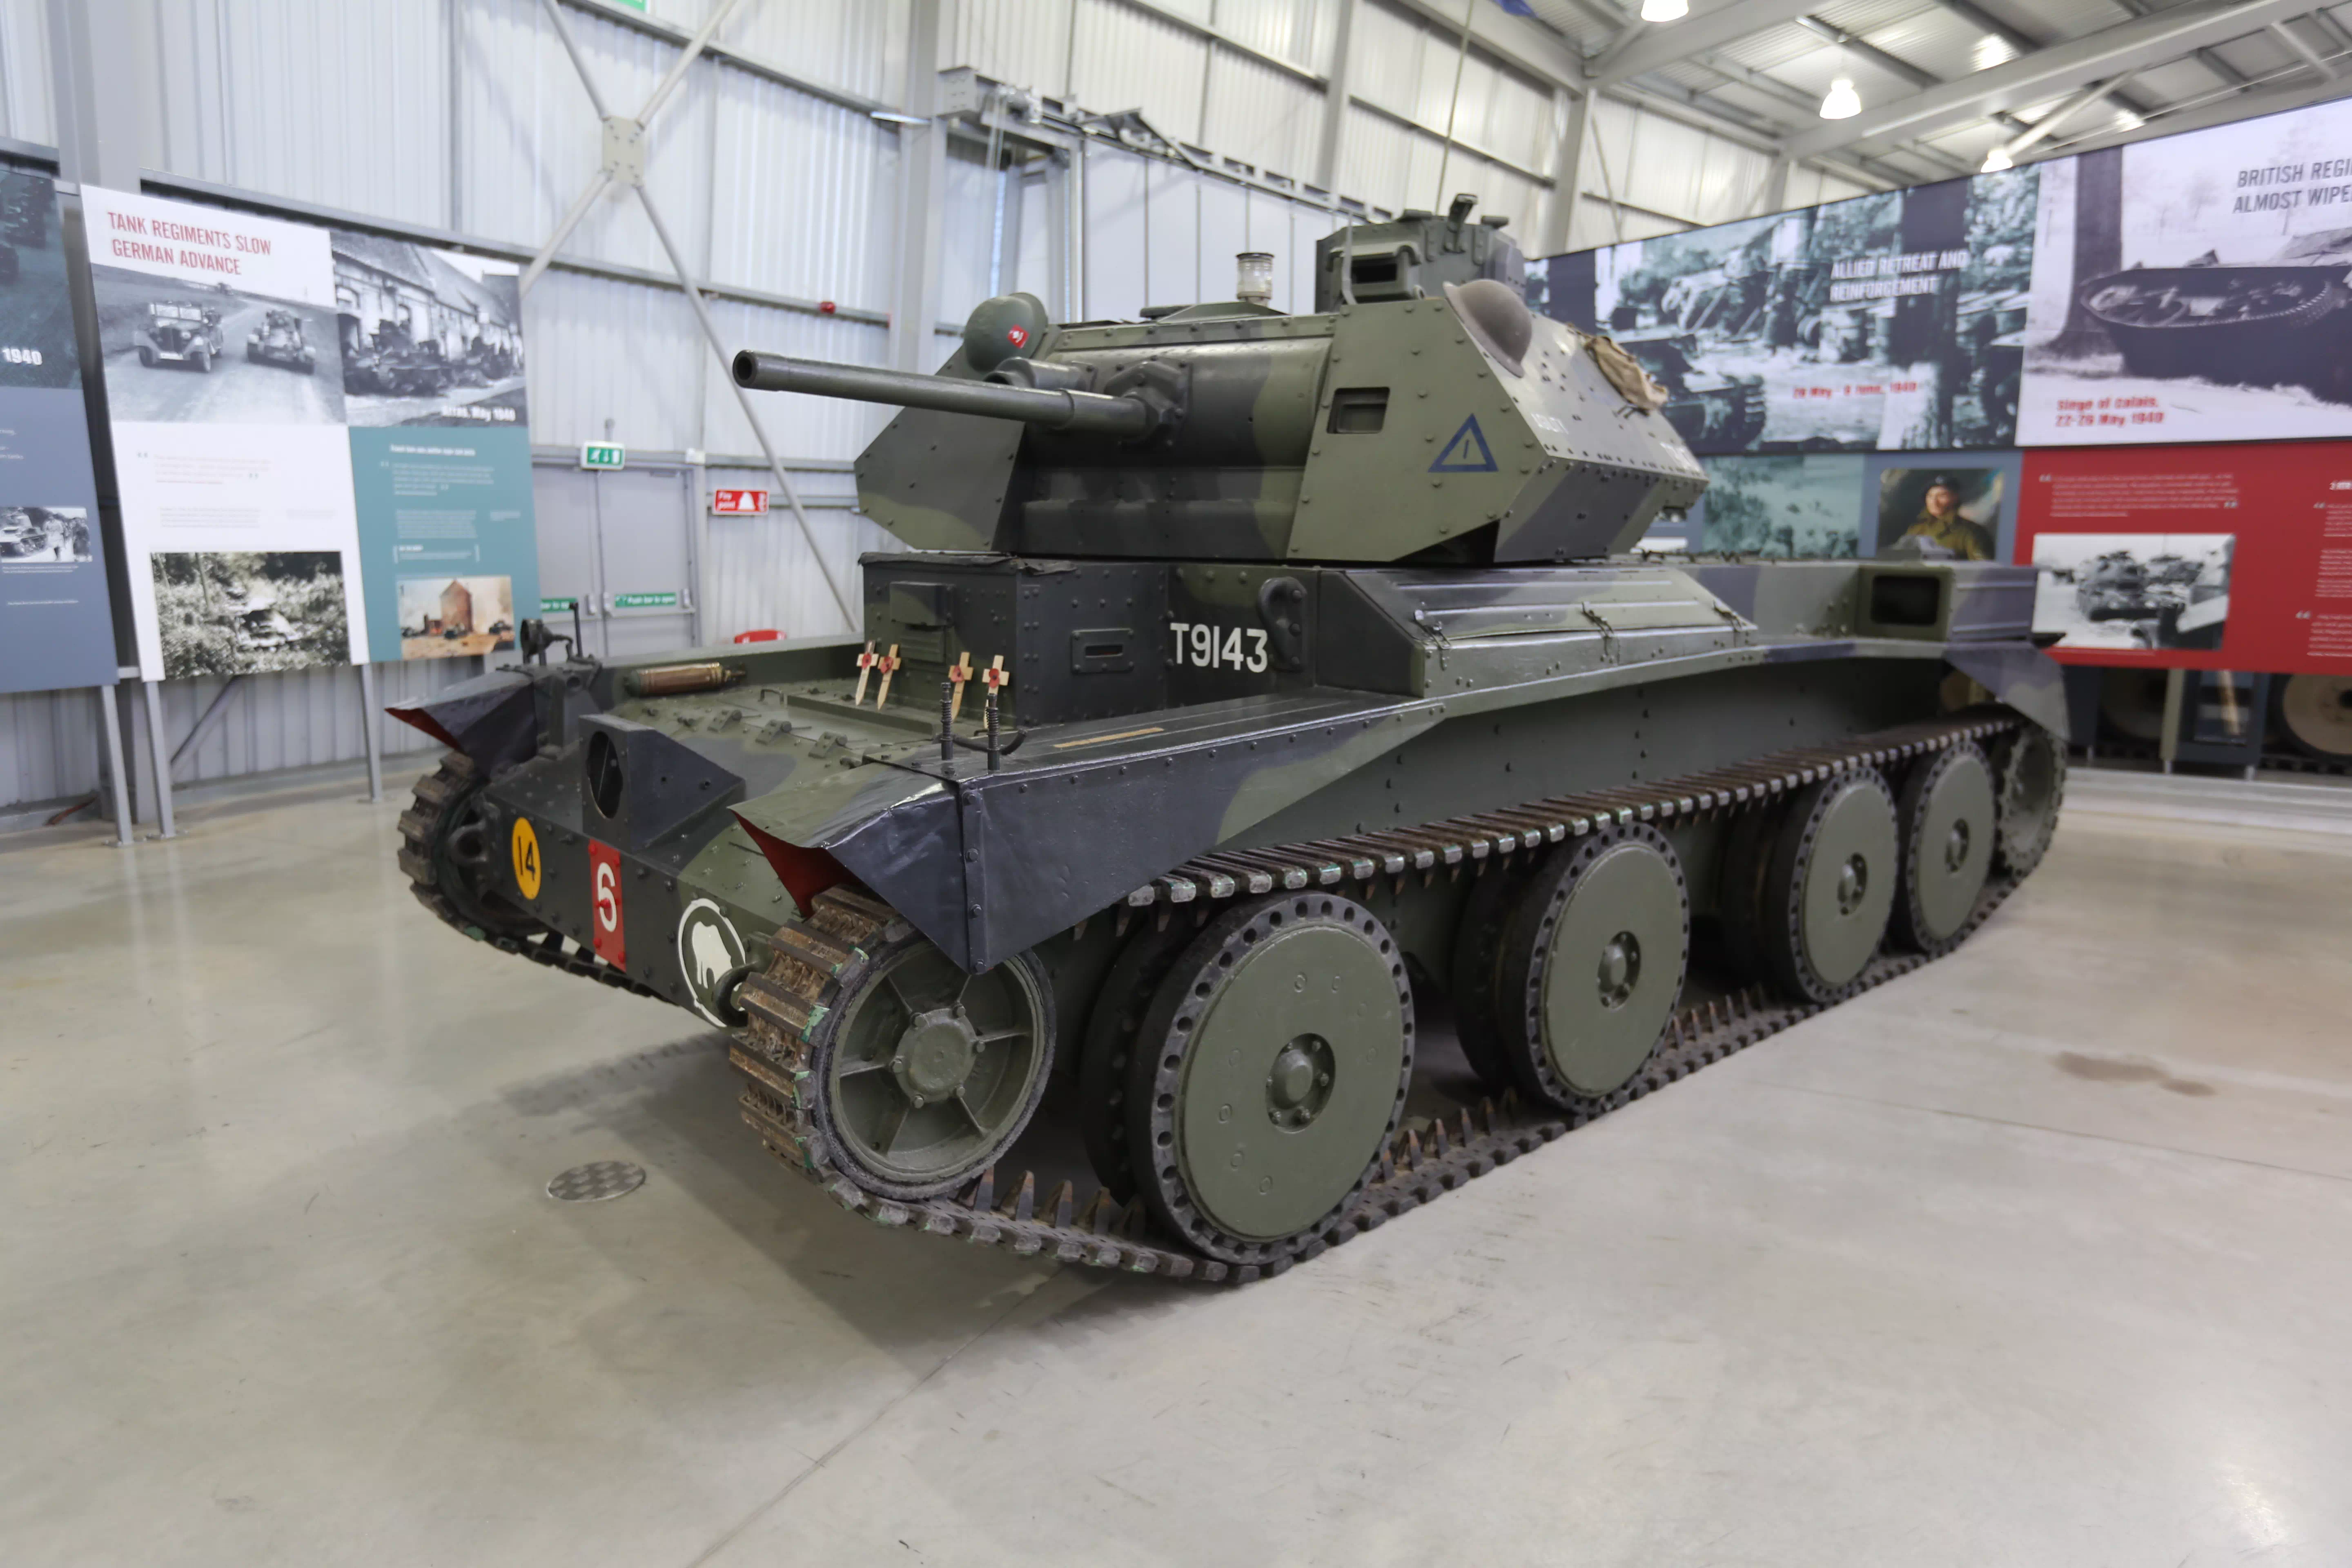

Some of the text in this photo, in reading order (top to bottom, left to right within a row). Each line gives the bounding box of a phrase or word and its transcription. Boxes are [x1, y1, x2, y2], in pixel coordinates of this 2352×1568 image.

[2237, 158, 2352, 188] BRITISH REGI
[2232, 185, 2352, 214] ALMOST WIPE
[108, 212, 271, 255] TANK REGIMENTS SLOW
[112, 239, 242, 275] GERMAN ADVANCE
[1831, 249, 1971, 280] ALLIED RETREAT AND
[1830, 273, 1941, 302] REINFORCEMENT
[2, 348, 42, 366] 1940
[1170, 623, 1267, 673] T9143
[519, 836, 536, 881] 14
[597, 862, 617, 932] 6
